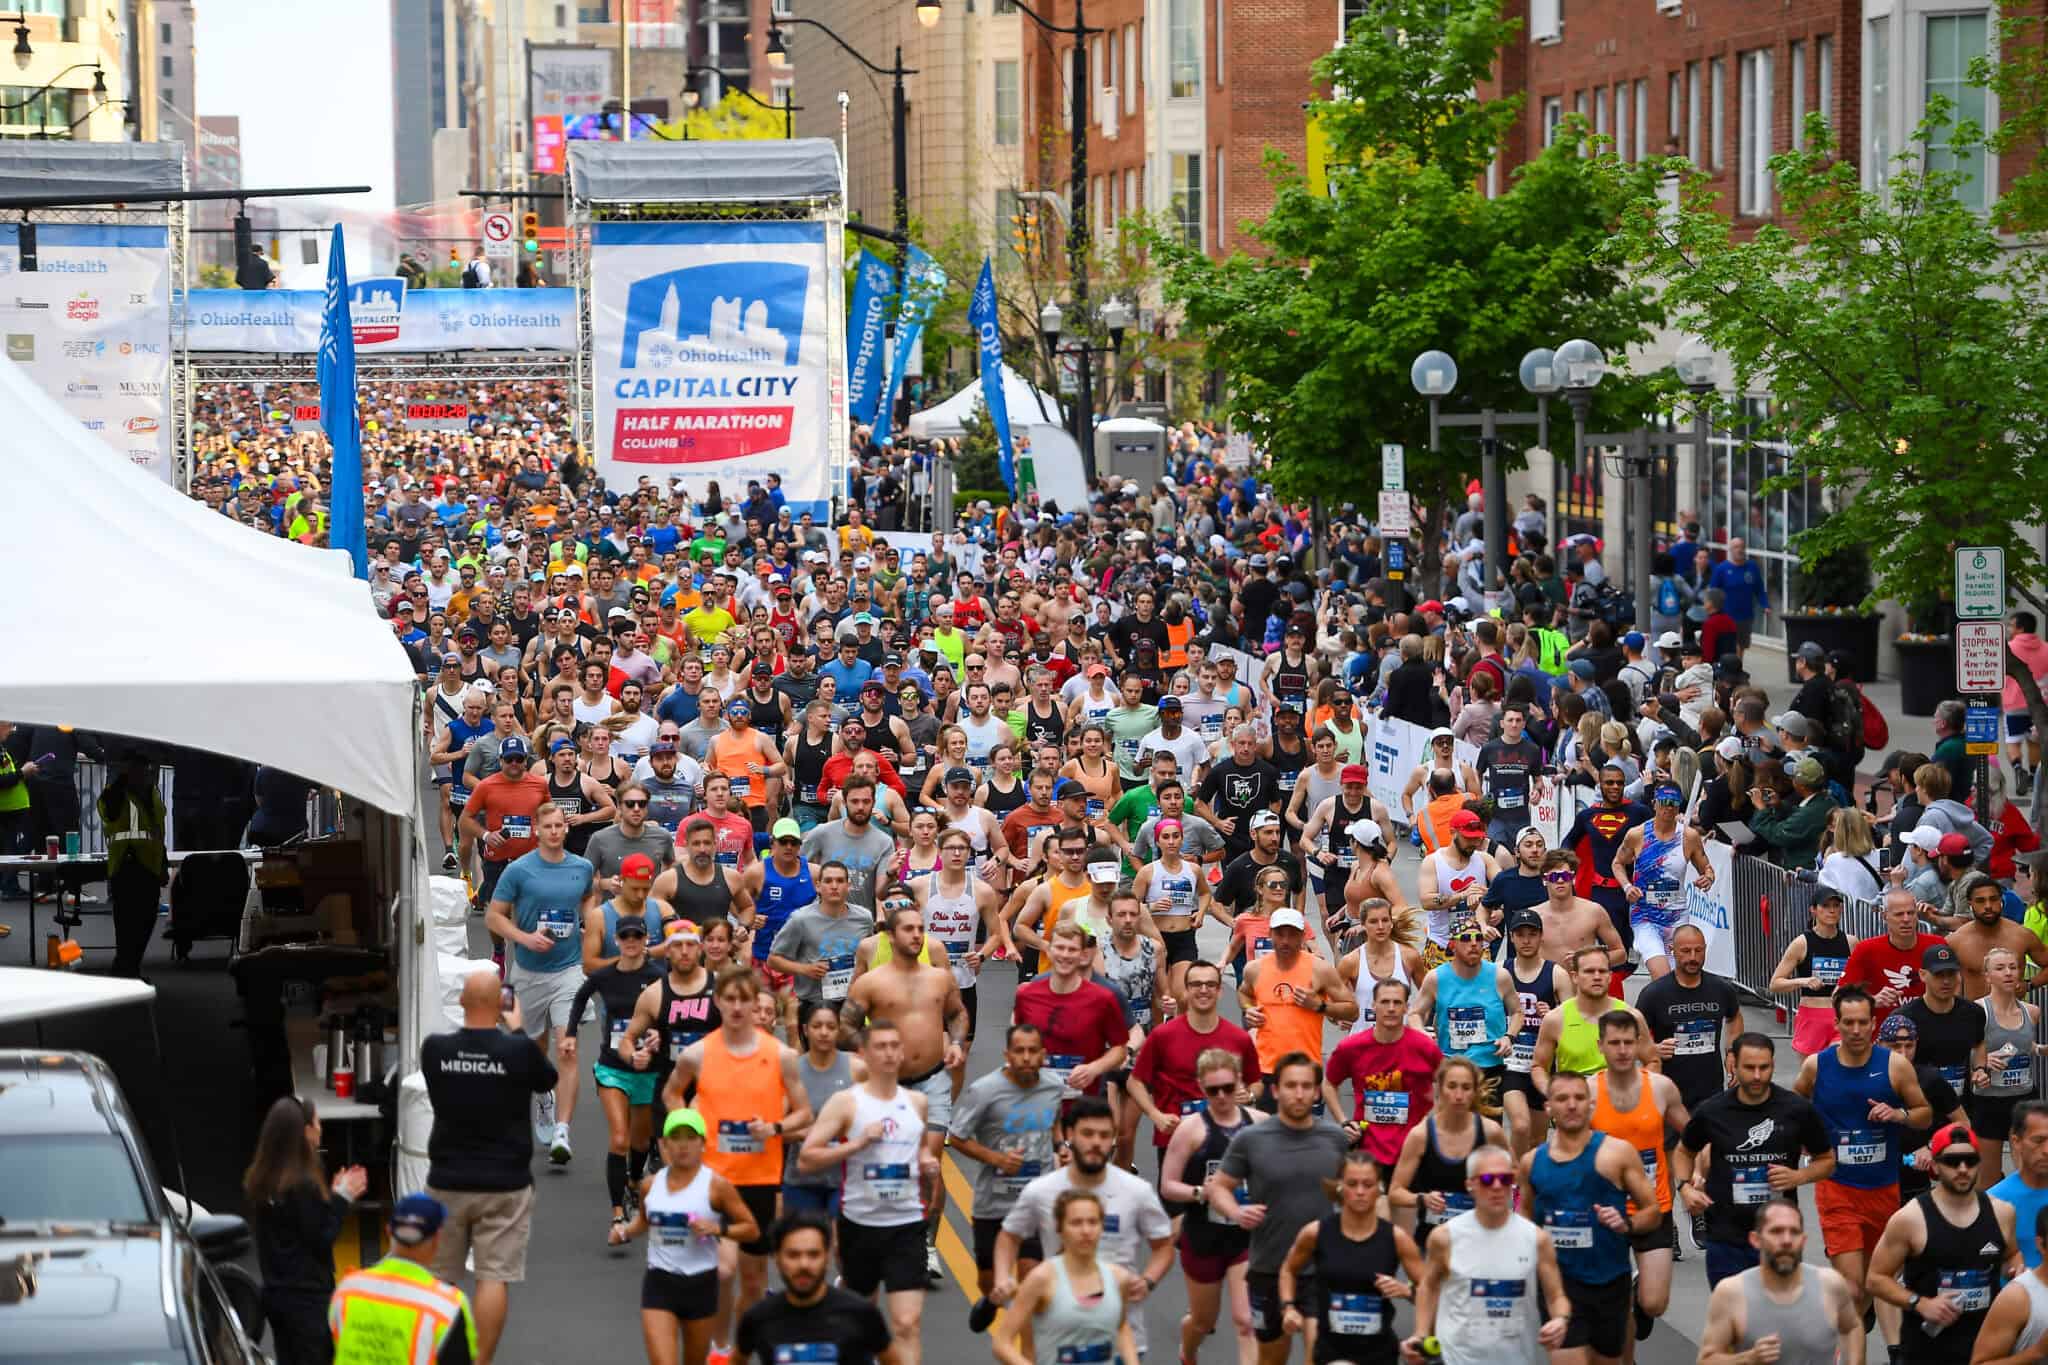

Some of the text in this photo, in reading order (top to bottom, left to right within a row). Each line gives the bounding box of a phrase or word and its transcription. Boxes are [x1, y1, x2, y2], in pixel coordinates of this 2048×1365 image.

[200, 312, 295, 327] OhioHealth
[469, 312, 561, 327] OhioHealth
[679, 348, 771, 363] OhioHealth
[850, 297, 882, 404] OhioHealth
[623, 414, 782, 431] HALF MARATHON
[622, 437, 695, 449] COLUMBUS
[1974, 627, 1987, 636] NO
[1962, 638, 2000, 648] STOPPING
[668, 997, 710, 1024] MU
[1668, 1002, 1720, 1015] FRIEND
[1454, 1022, 1478, 1030] RYAN
[440, 1060, 505, 1075] MEDICAL
[1372, 1107, 1400, 1115] CHAD
[1847, 1146, 1876, 1155] MATT
[1749, 1153, 1787, 1163] STRONG
